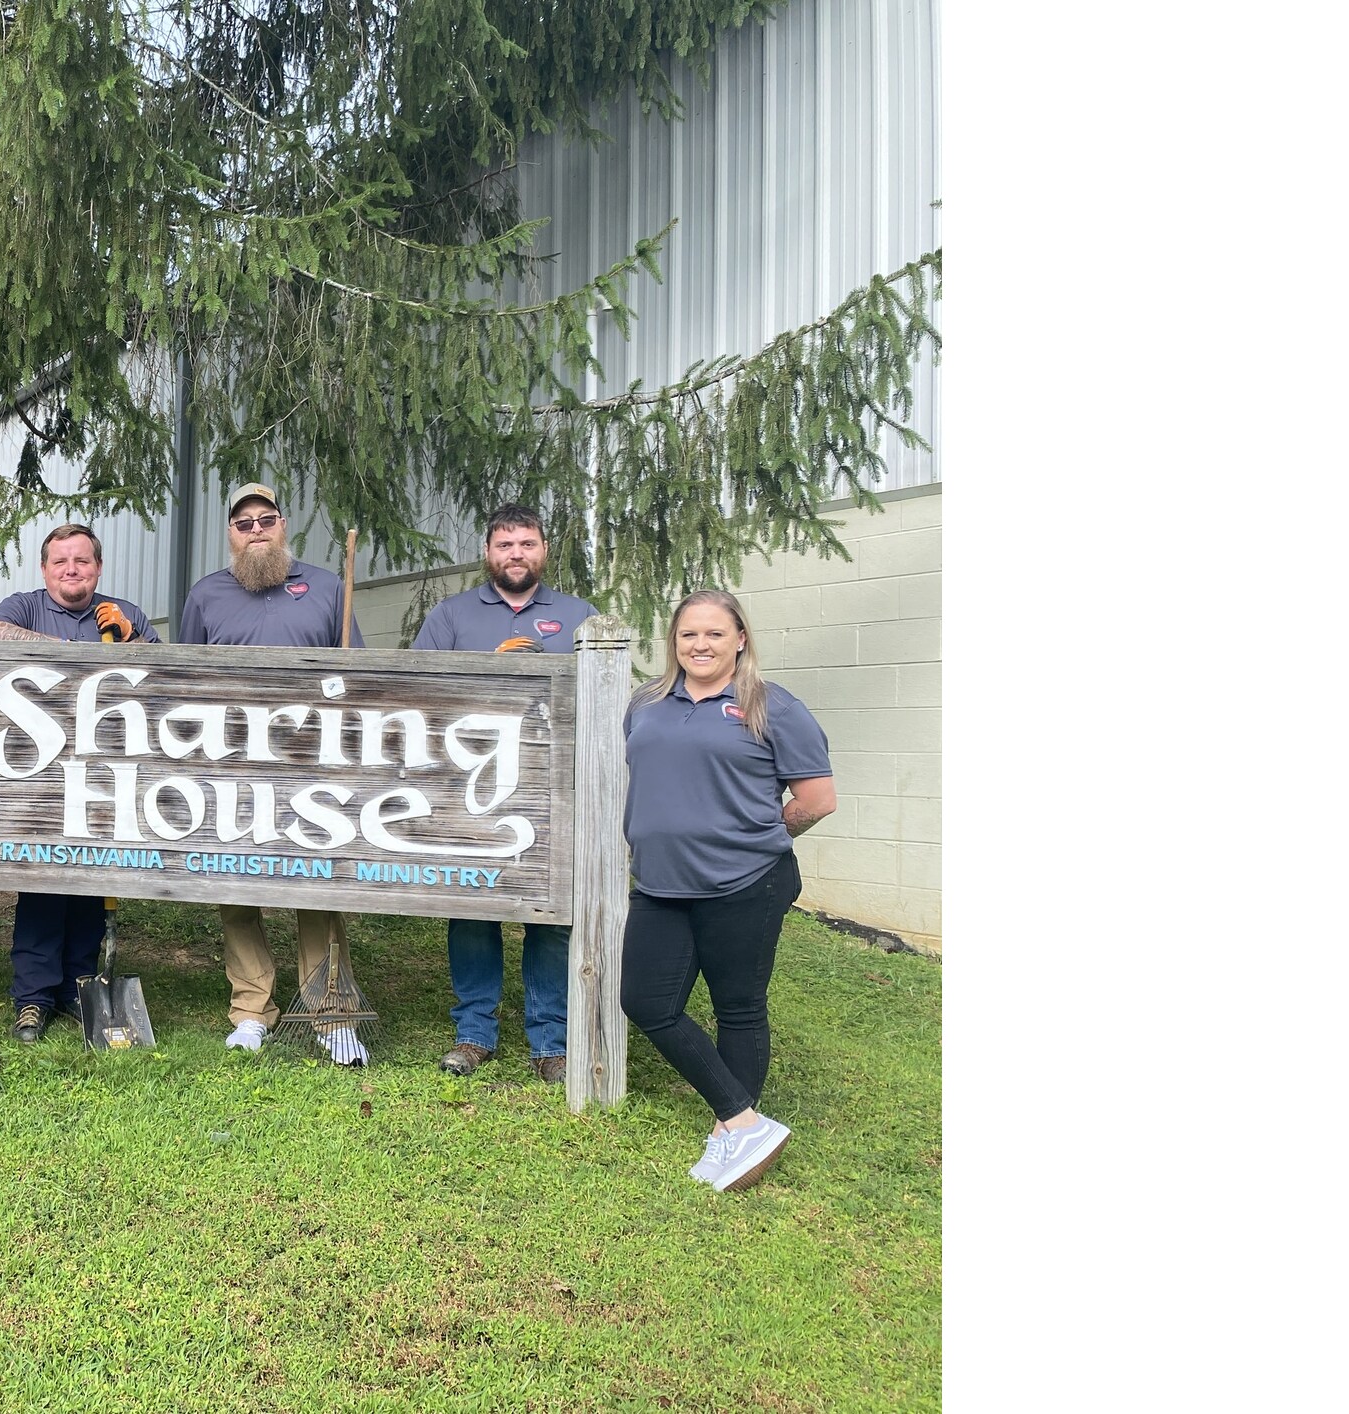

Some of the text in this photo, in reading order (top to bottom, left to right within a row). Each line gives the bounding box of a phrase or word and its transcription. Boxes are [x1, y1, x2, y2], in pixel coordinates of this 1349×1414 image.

[60, 760, 537, 858] House
[185, 851, 334, 880] CHRISTIAN
[354, 862, 502, 889] MINISTRY
